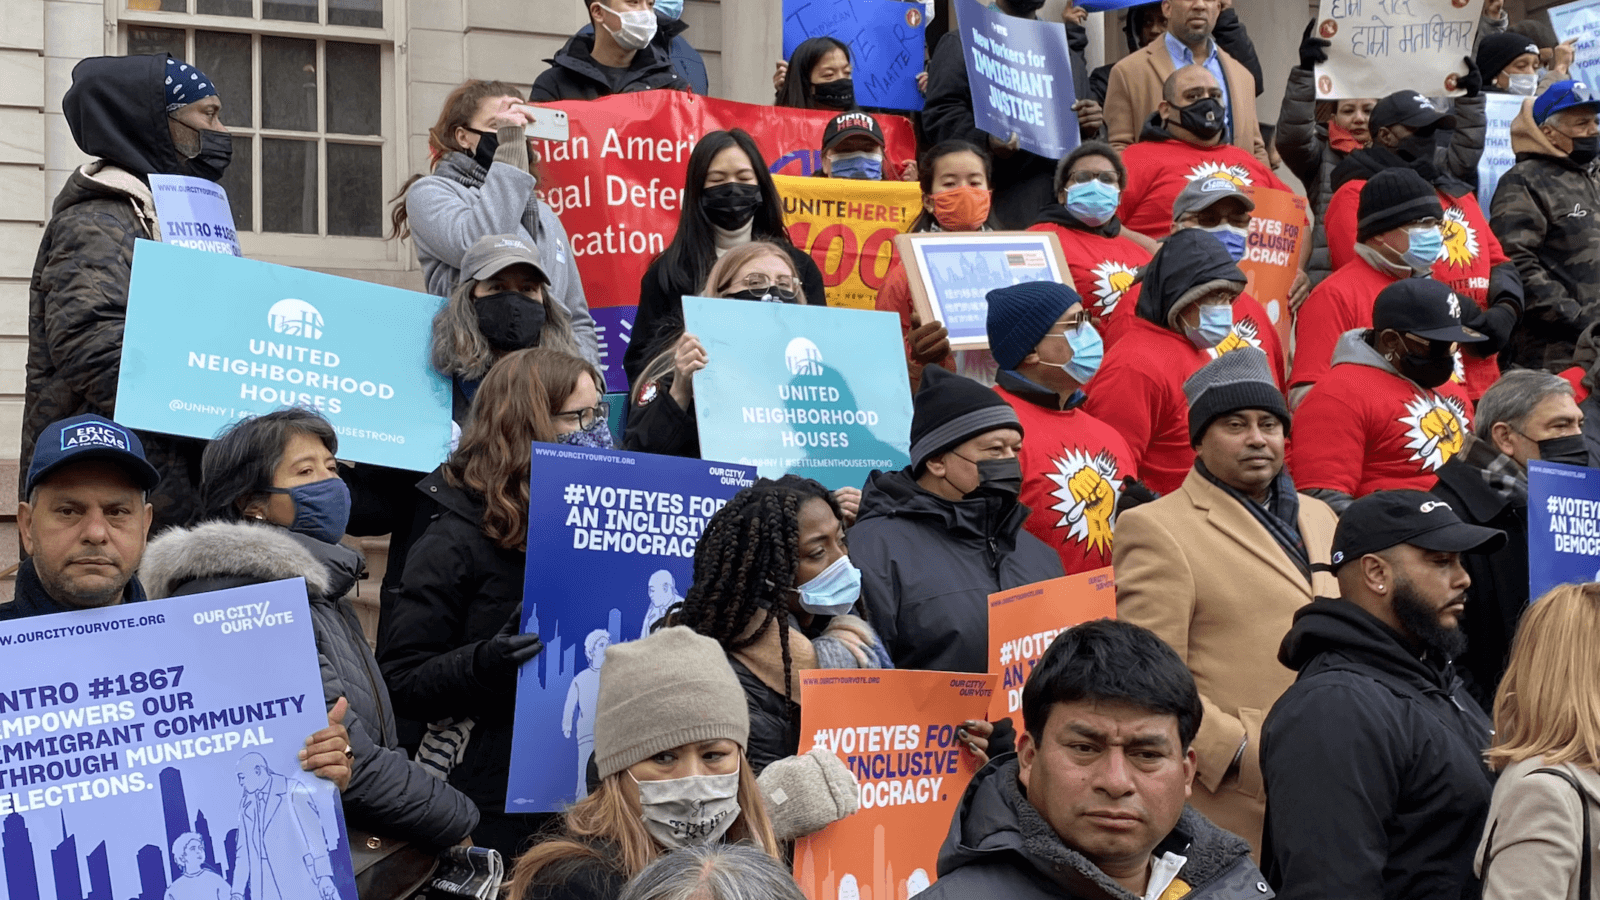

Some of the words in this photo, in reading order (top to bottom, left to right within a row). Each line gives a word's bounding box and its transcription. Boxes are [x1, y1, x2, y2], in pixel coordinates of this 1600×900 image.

[972, 27, 989, 51] New
[989, 38, 1025, 65] Yorkers
[1027, 50, 1046, 68] for
[971, 46, 1053, 99] IMMIGRANT
[837, 113, 873, 125] UNITE
[989, 84, 1045, 127] JUSTICE
[531, 136, 589, 163] sian
[600, 127, 695, 163] Ameri
[534, 176, 590, 216] egal
[606, 175, 684, 210] Defe
[167, 221, 211, 237] INTRO
[570, 223, 664, 256] cation
[1249, 217, 1282, 235] EYES
[1284, 223, 1299, 238] FOR
[1248, 232, 1296, 253] CLUSIVE
[250, 339, 340, 368] UNITED
[188, 352, 395, 399] NEIGHBORHOOD
[241, 383, 342, 414] HOUSES
[779, 385, 840, 402] UNITED
[169, 400, 226, 417] @UNHNY
[742, 407, 879, 426] NEIGHBORHOOD
[67, 434, 125, 449] ADAMS
[77, 427, 114, 438] ERIC
[781, 431, 849, 448] HOUSES
[535, 448, 636, 465] WWW.OURCITYOURVOTE.ORG
[709, 467, 725, 476] OUR
[721, 476, 735, 486] OUR
[564, 483, 683, 514] #VOTEYES
[1547, 495, 1600, 519] #VOTEY
[566, 506, 599, 528] AN
[605, 509, 711, 537] INCLUSIV
[1549, 514, 1567, 533] AN
[1570, 517, 1600, 537] INCL
[573, 528, 699, 558] DEMOCRAC
[0, 614, 166, 646] W.OURCITYOURVOTE.ORG
[193, 608, 227, 625] OUR
[229, 602, 262, 620] CITY
[221, 620, 252, 634] OUR
[1000, 627, 1070, 666] #VOTE
[0, 682, 79, 714] NTRO
[88, 665, 184, 700] #1867
[950, 680, 964, 688] OUR
[1003, 662, 1024, 690] AN
[142, 691, 194, 716] OUR
[959, 688, 974, 696] OUR
[153, 694, 306, 738] COMMUNITY
[126, 725, 273, 769] MUNICIPAL
[812, 724, 920, 754] #VOTEYES
[848, 750, 959, 780] INCLUSIVE
[0, 771, 154, 816] ELECTIONS.
[857, 777, 947, 809] OCRACY.
